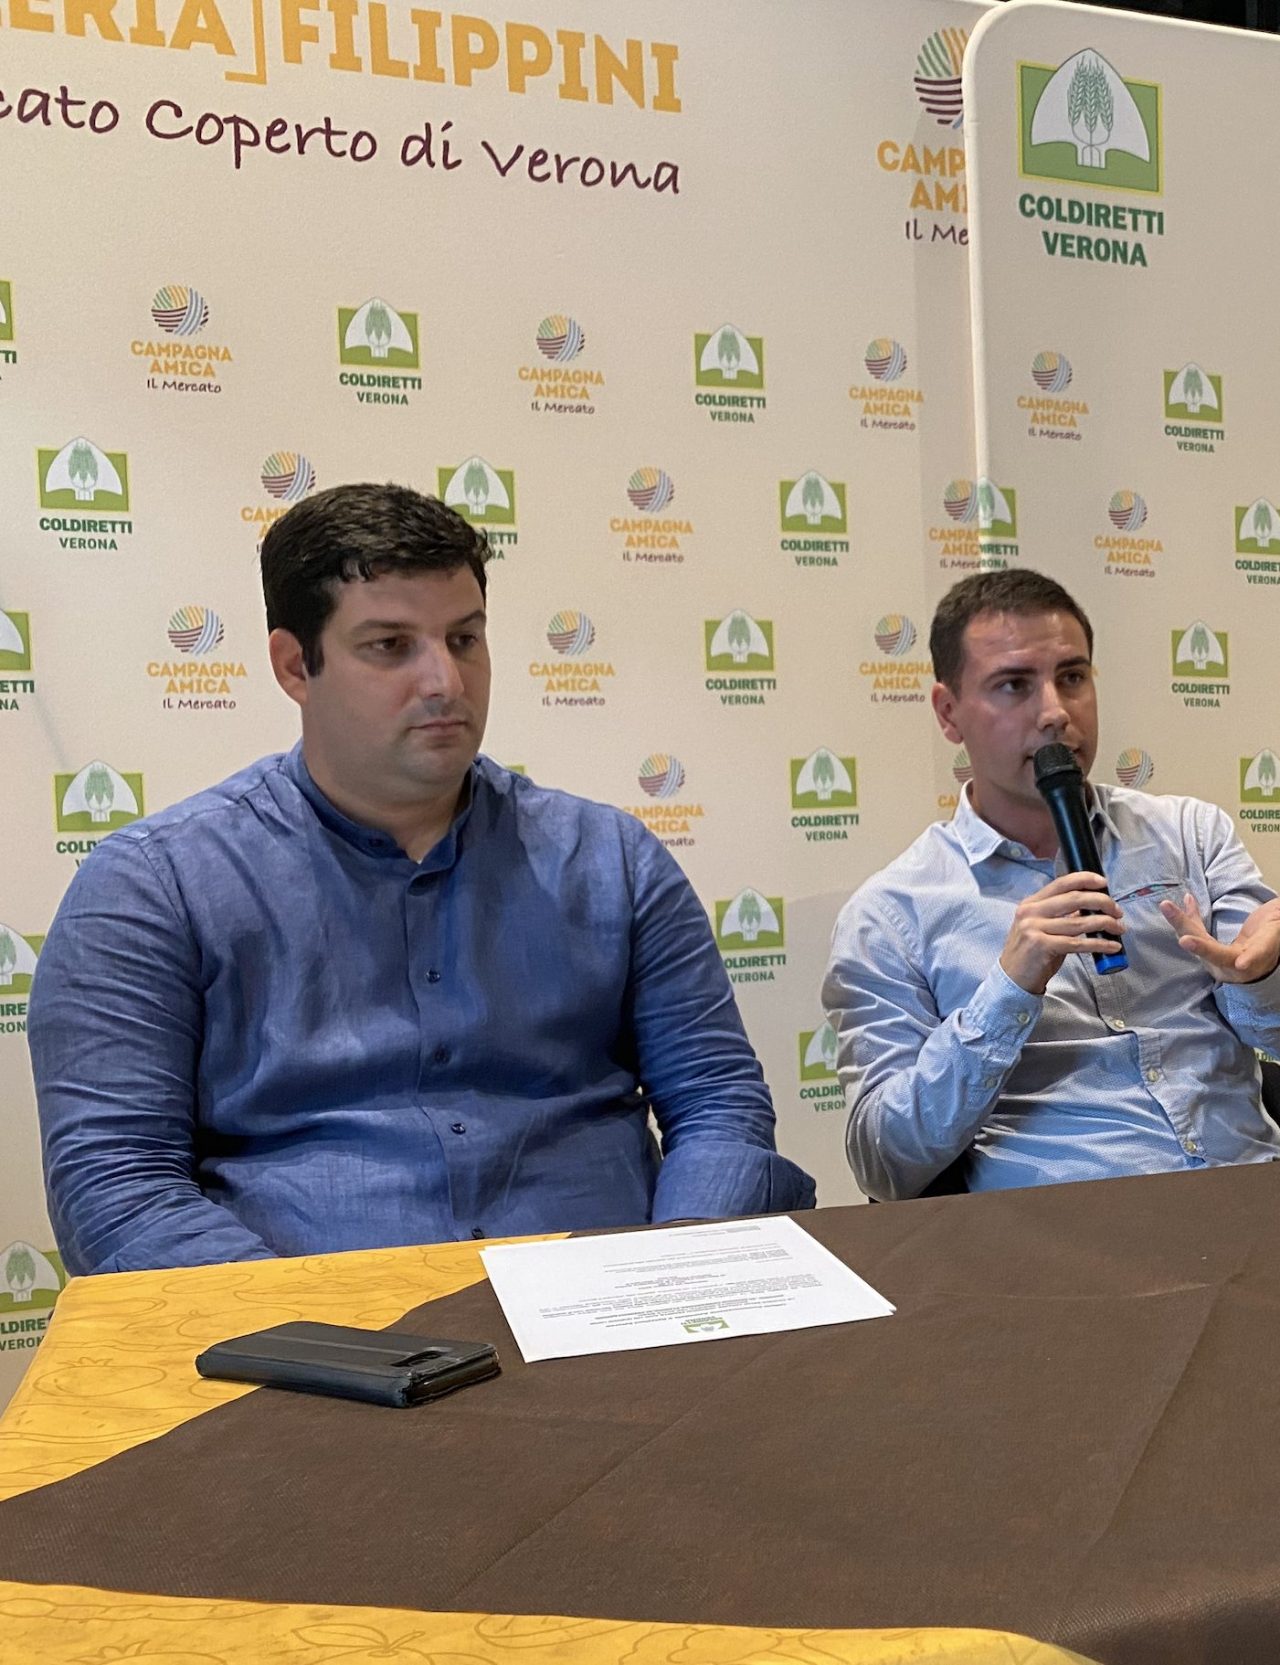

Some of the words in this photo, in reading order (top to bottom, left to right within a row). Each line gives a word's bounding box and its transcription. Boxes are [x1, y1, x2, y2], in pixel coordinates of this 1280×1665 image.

[281, 0, 682, 113] FILIPPINI
[146, 100, 378, 168] Coperto
[401, 121, 462, 171] di
[481, 139, 680, 194] Verona
[877, 140, 966, 178] CAMP
[1018, 193, 1165, 236] COLDIRETTI
[906, 218, 923, 240] Il
[1042, 231, 1148, 268] VERONA
[131, 341, 232, 362] CAMPAGNA
[150, 360, 215, 377] AMICA
[339, 373, 421, 389] COLDIRETTI
[518, 367, 604, 386] CAMPAGNA
[162, 381, 221, 393] Mercato
[534, 384, 589, 400] AMICA
[357, 392, 408, 405] VERONA
[695, 394, 766, 408] COLDIRETTI
[849, 387, 924, 404] CAMPAGNA
[863, 402, 911, 417] AMICA
[1017, 396, 1089, 416] CAMPAGNA
[710, 411, 754, 422] VERONA
[1031, 412, 1080, 429] AMICA
[1165, 425, 1224, 440] COLDIRETTI
[1177, 442, 1214, 453] VERONA
[40, 518, 132, 533] COLDIRETTI
[610, 519, 693, 536] CAMPAGNA
[59, 538, 117, 550] VERONA
[625, 534, 679, 548] AMICA
[781, 539, 849, 552] COLDIRETTI
[1094, 536, 1163, 554] CAMPAGNA
[795, 556, 838, 566] VERONA
[1107, 550, 1151, 566] AMICA
[147, 662, 247, 678] CAMPAGNA
[529, 662, 615, 678] CAMPAGNA
[859, 662, 933, 677] CAMPAGNA
[166, 678, 230, 694] AMICA
[545, 677, 600, 692] AMICA
[706, 678, 776, 690] COLDIRETTI
[873, 676, 921, 689] AMICA
[1172, 683, 1230, 694] COLDIRETTI
[721, 695, 765, 705] VERONA
[1184, 698, 1220, 707] VERONA
[791, 814, 859, 827] COLDIRETTI
[806, 831, 848, 841] VERONA
[724, 954, 786, 969] OLDIRETTI
[729, 971, 775, 984] VERONA
[0, 1318, 46, 1334] LDIRE
[0, 1336, 44, 1350] VERON
